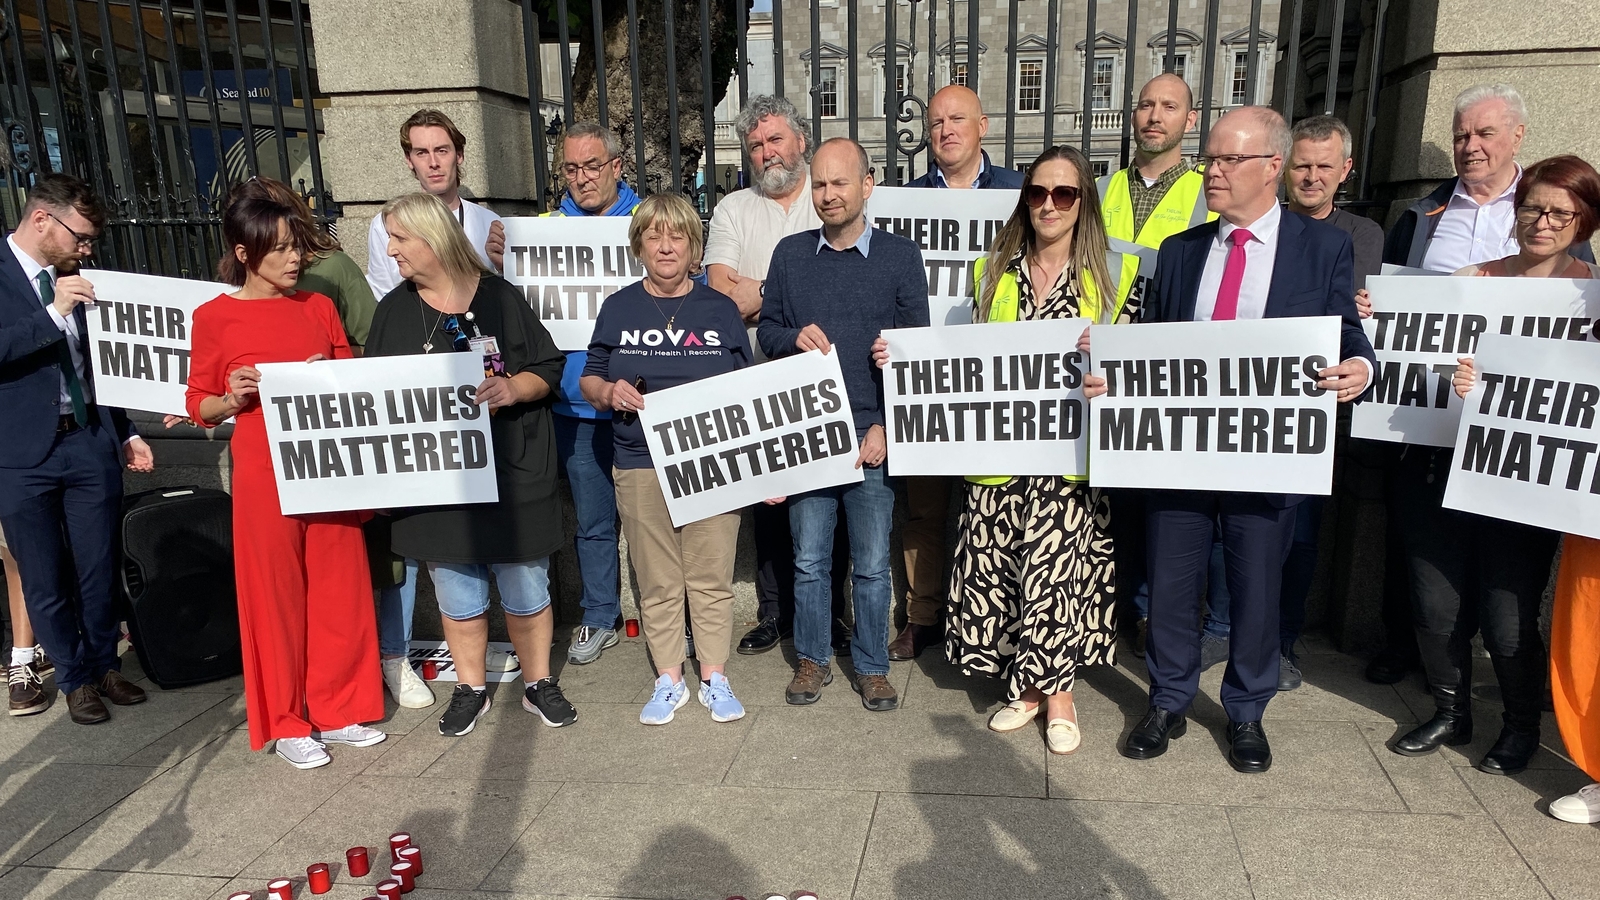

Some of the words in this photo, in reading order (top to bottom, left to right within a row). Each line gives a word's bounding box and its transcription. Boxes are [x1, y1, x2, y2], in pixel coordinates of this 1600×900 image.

[222, 88, 258, 98] Seaad
[874, 217, 960, 251] THEIR
[511, 246, 595, 277] THEIR
[602, 246, 644, 277] LIV
[94, 300, 186, 340] THEIR
[620, 329, 721, 347] NOVAS
[1372, 312, 1487, 354] THEIR
[98, 340, 192, 385] MATT
[892, 357, 984, 395] THEIR
[993, 352, 1082, 391] LIVES
[1100, 359, 1208, 397] THEIR
[1219, 355, 1328, 397] LIVES
[271, 391, 378, 432] THEIR
[384, 384, 481, 425] LIVES
[652, 404, 750, 457] THEIR
[752, 378, 842, 432] LIVES
[893, 399, 1082, 443] MATTERED
[1479, 372, 1600, 430] THEIR
[1100, 408, 1328, 455] MATTERED
[279, 429, 488, 480] MATTERED
[664, 420, 852, 499] MATTERED
[1461, 424, 1600, 495] MATT
[409, 649, 452, 658] THEI
